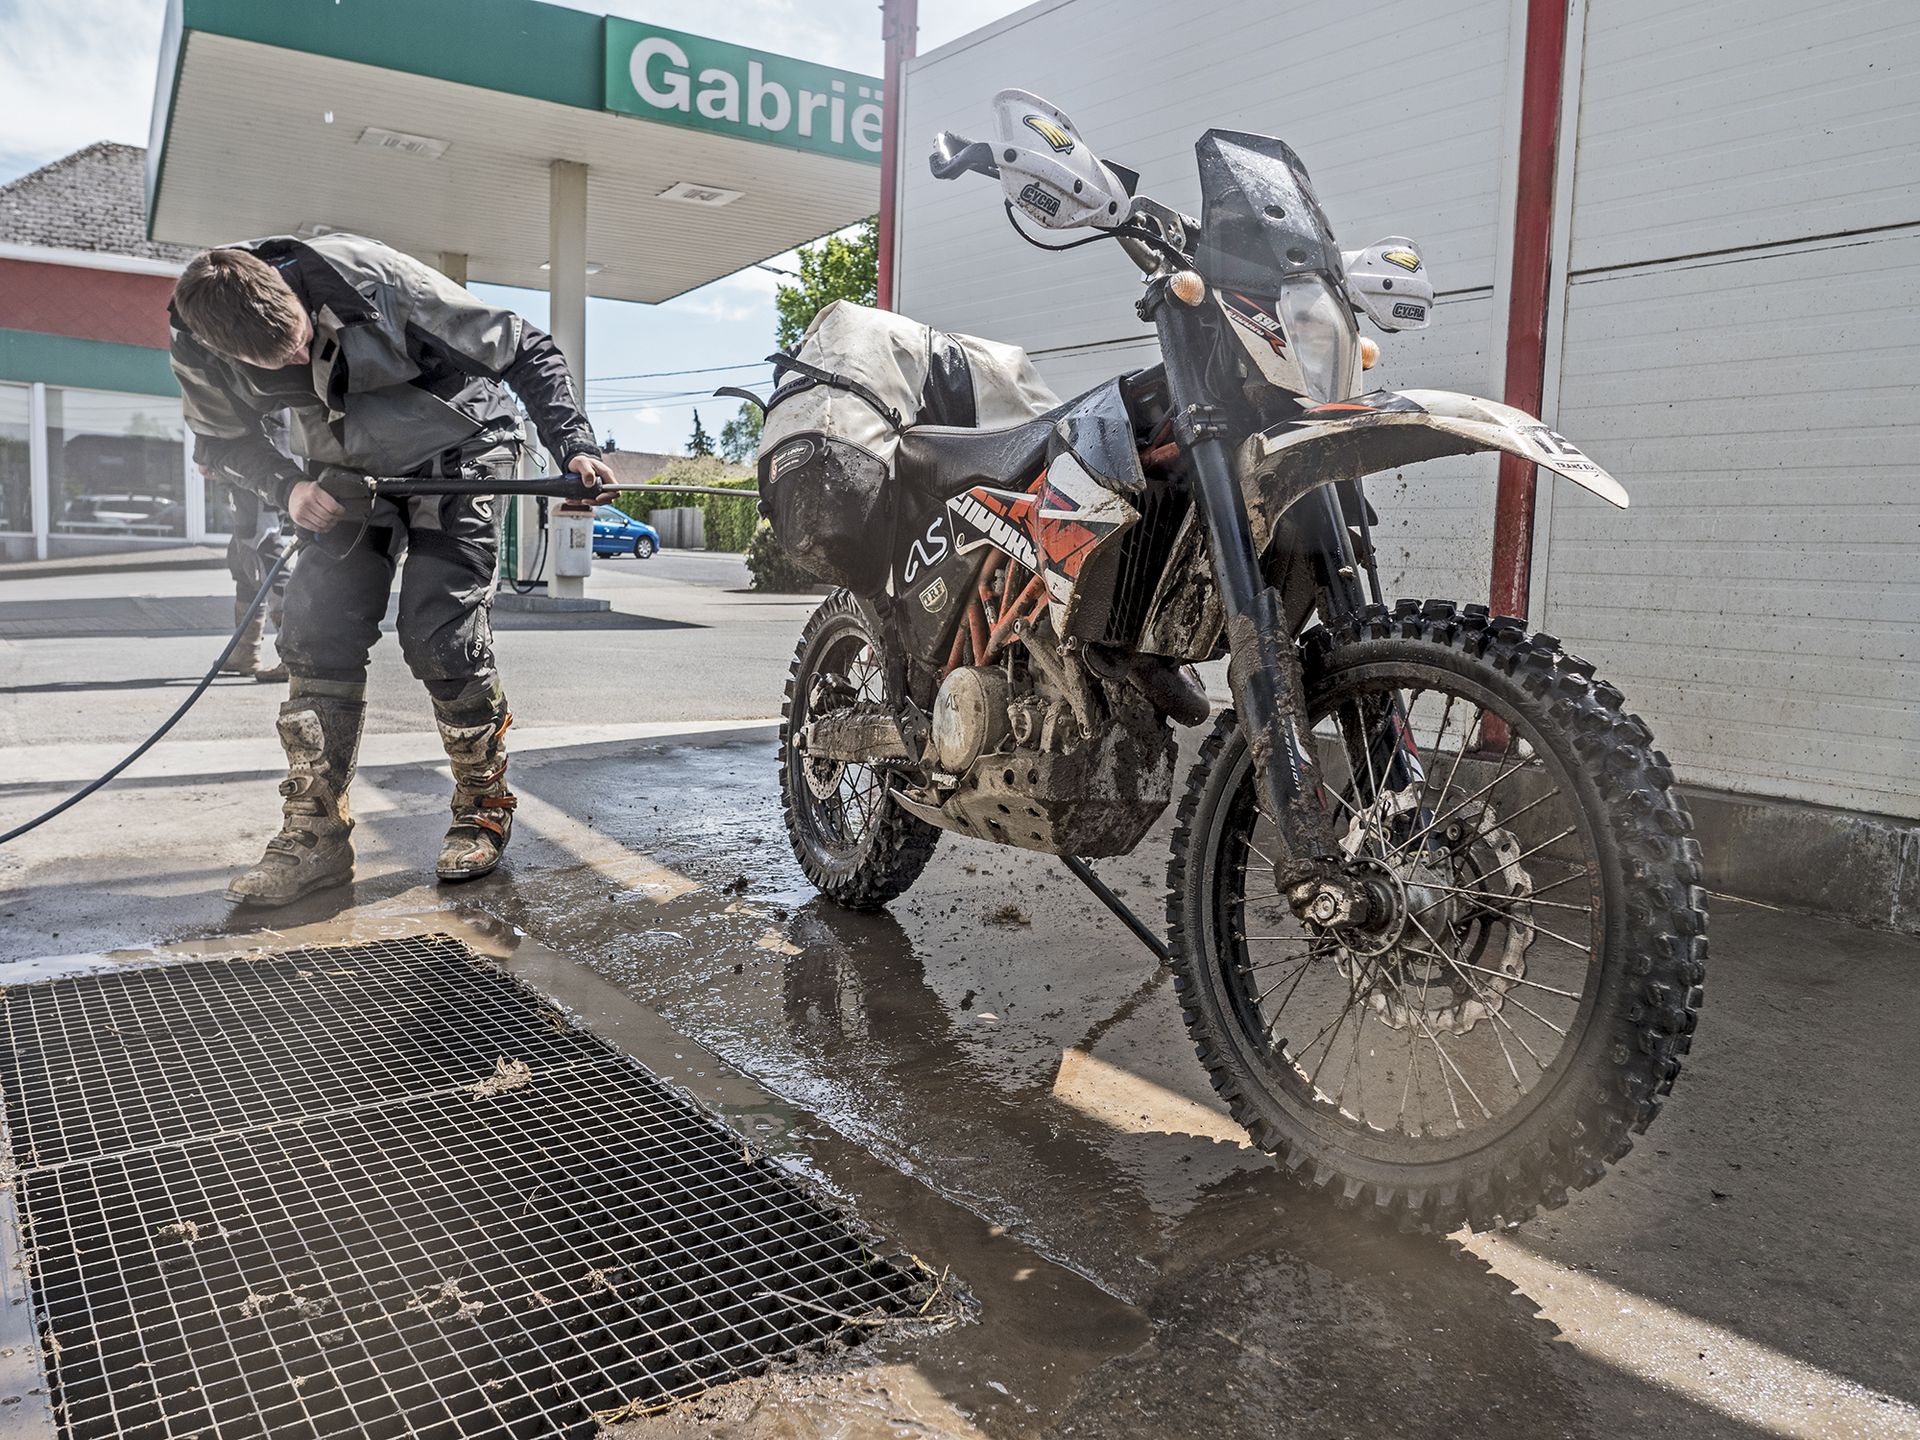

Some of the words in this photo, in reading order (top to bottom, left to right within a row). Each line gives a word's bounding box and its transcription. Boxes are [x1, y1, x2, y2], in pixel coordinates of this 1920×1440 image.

[629, 37, 883, 152] Gabrië
[1022, 186, 1060, 215] CYCRA
[1251, 312, 1281, 331] 690
[1395, 304, 1425, 319] CYCRA
[922, 582, 946, 606] TRF
